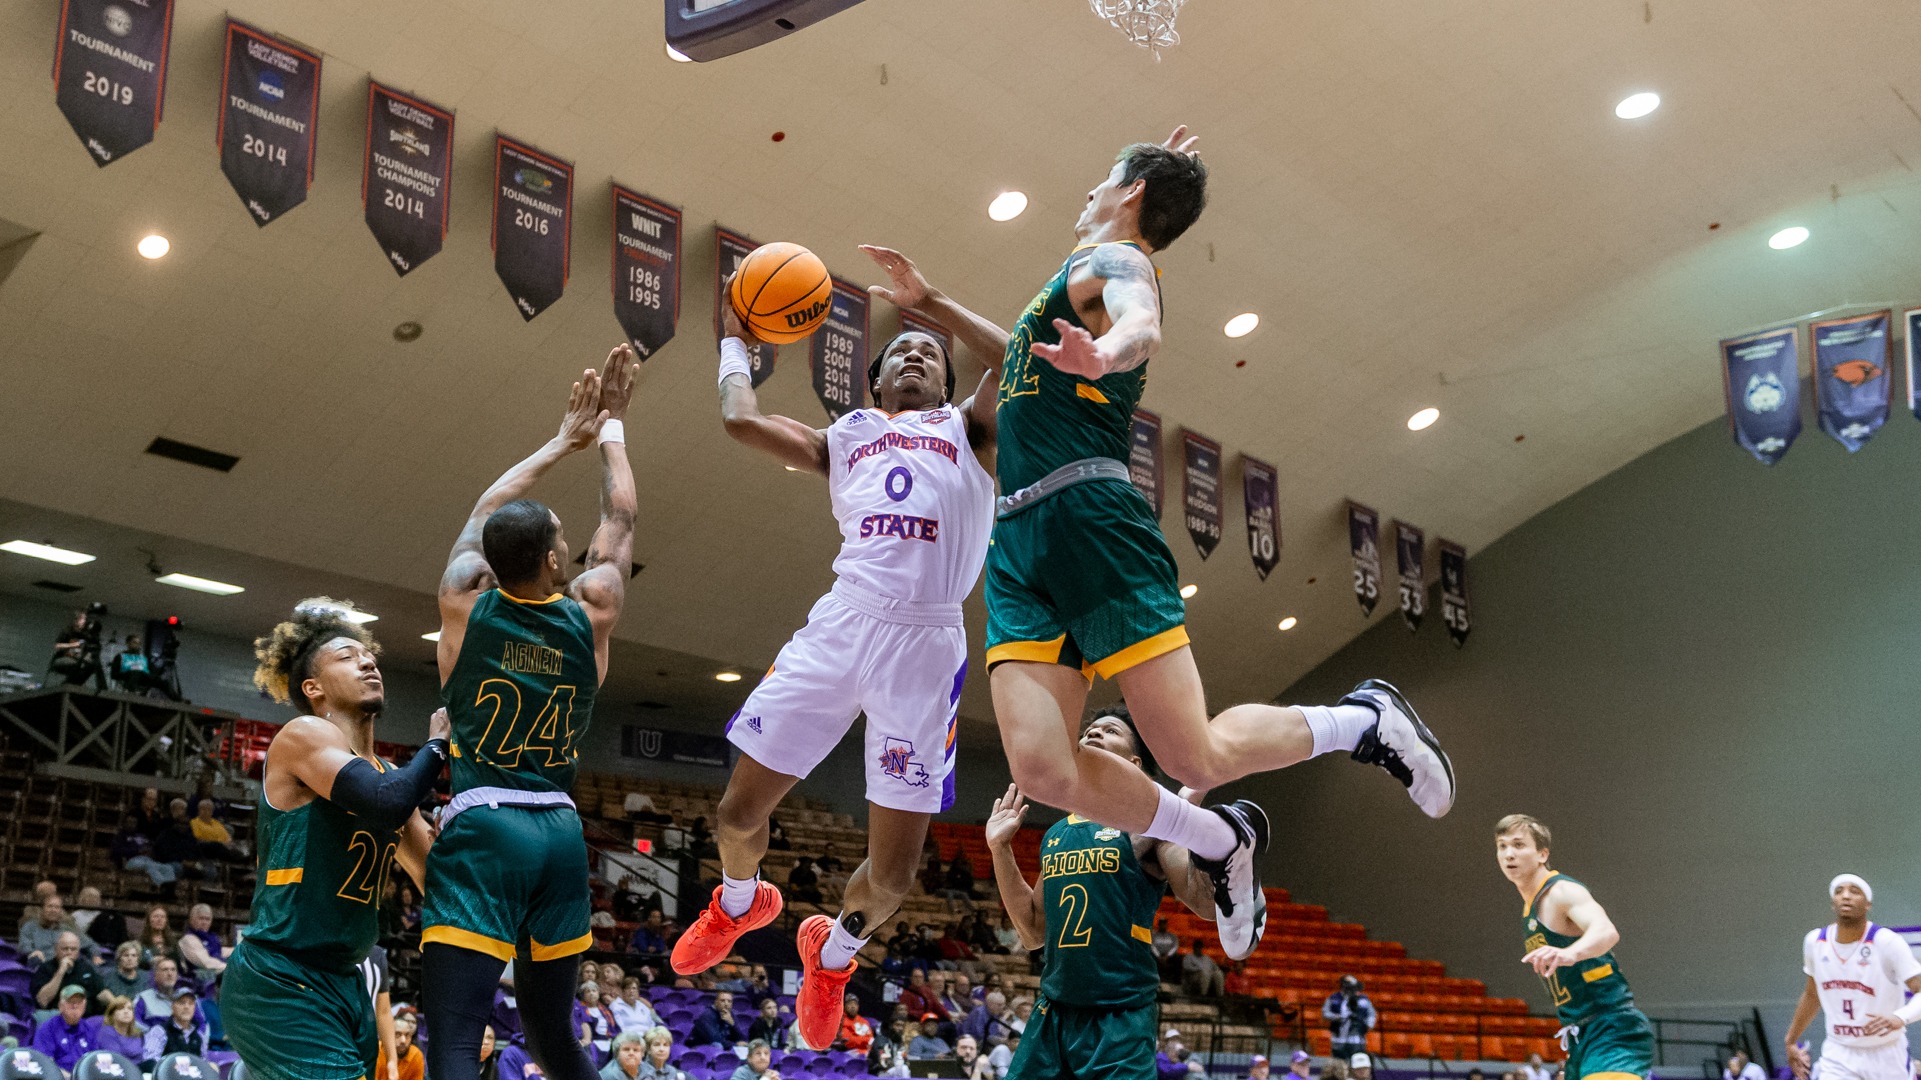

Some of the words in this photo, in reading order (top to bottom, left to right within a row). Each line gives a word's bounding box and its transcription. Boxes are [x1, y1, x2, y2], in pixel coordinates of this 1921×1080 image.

[70, 29, 156, 73] TOURNAMENT
[83, 70, 134, 106] 2019
[259, 81, 285, 99] NCAA
[230, 95, 306, 134] TOURNAMENT
[242, 134, 288, 166] 2014
[373, 152, 441, 188] TOURNAMENT
[377, 166, 436, 198] CHAMPIONS
[384, 188, 424, 219] 2014
[502, 186, 563, 218] TOURNAMENT
[515, 208, 549, 236] 2016
[631, 212, 662, 239] WNIT
[391, 251, 409, 271] NSU
[618, 233, 673, 262] TOURNAMENT
[629, 266, 661, 292] 1986
[518, 297, 535, 316] NSU
[629, 285, 661, 310] 1995
[784, 291, 832, 329] Wilso
[826, 332, 854, 354] 1989
[823, 349, 851, 372] 2004
[824, 366, 851, 388] 2014
[824, 384, 851, 406] 2015
[847, 432, 960, 476] NORTHWESTERN
[885, 466, 913, 502] 0
[860, 513, 939, 544] STATE
[1251, 531, 1274, 561] 10
[1354, 570, 1377, 598] 25
[1400, 587, 1423, 616] 33
[1442, 604, 1468, 632] 45
[501, 641, 563, 675] AGNEW
[474, 678, 576, 767] 24
[1042, 847, 1120, 880] LIONS
[1058, 883, 1093, 948] 2
[1843, 999, 1855, 1020] 4
